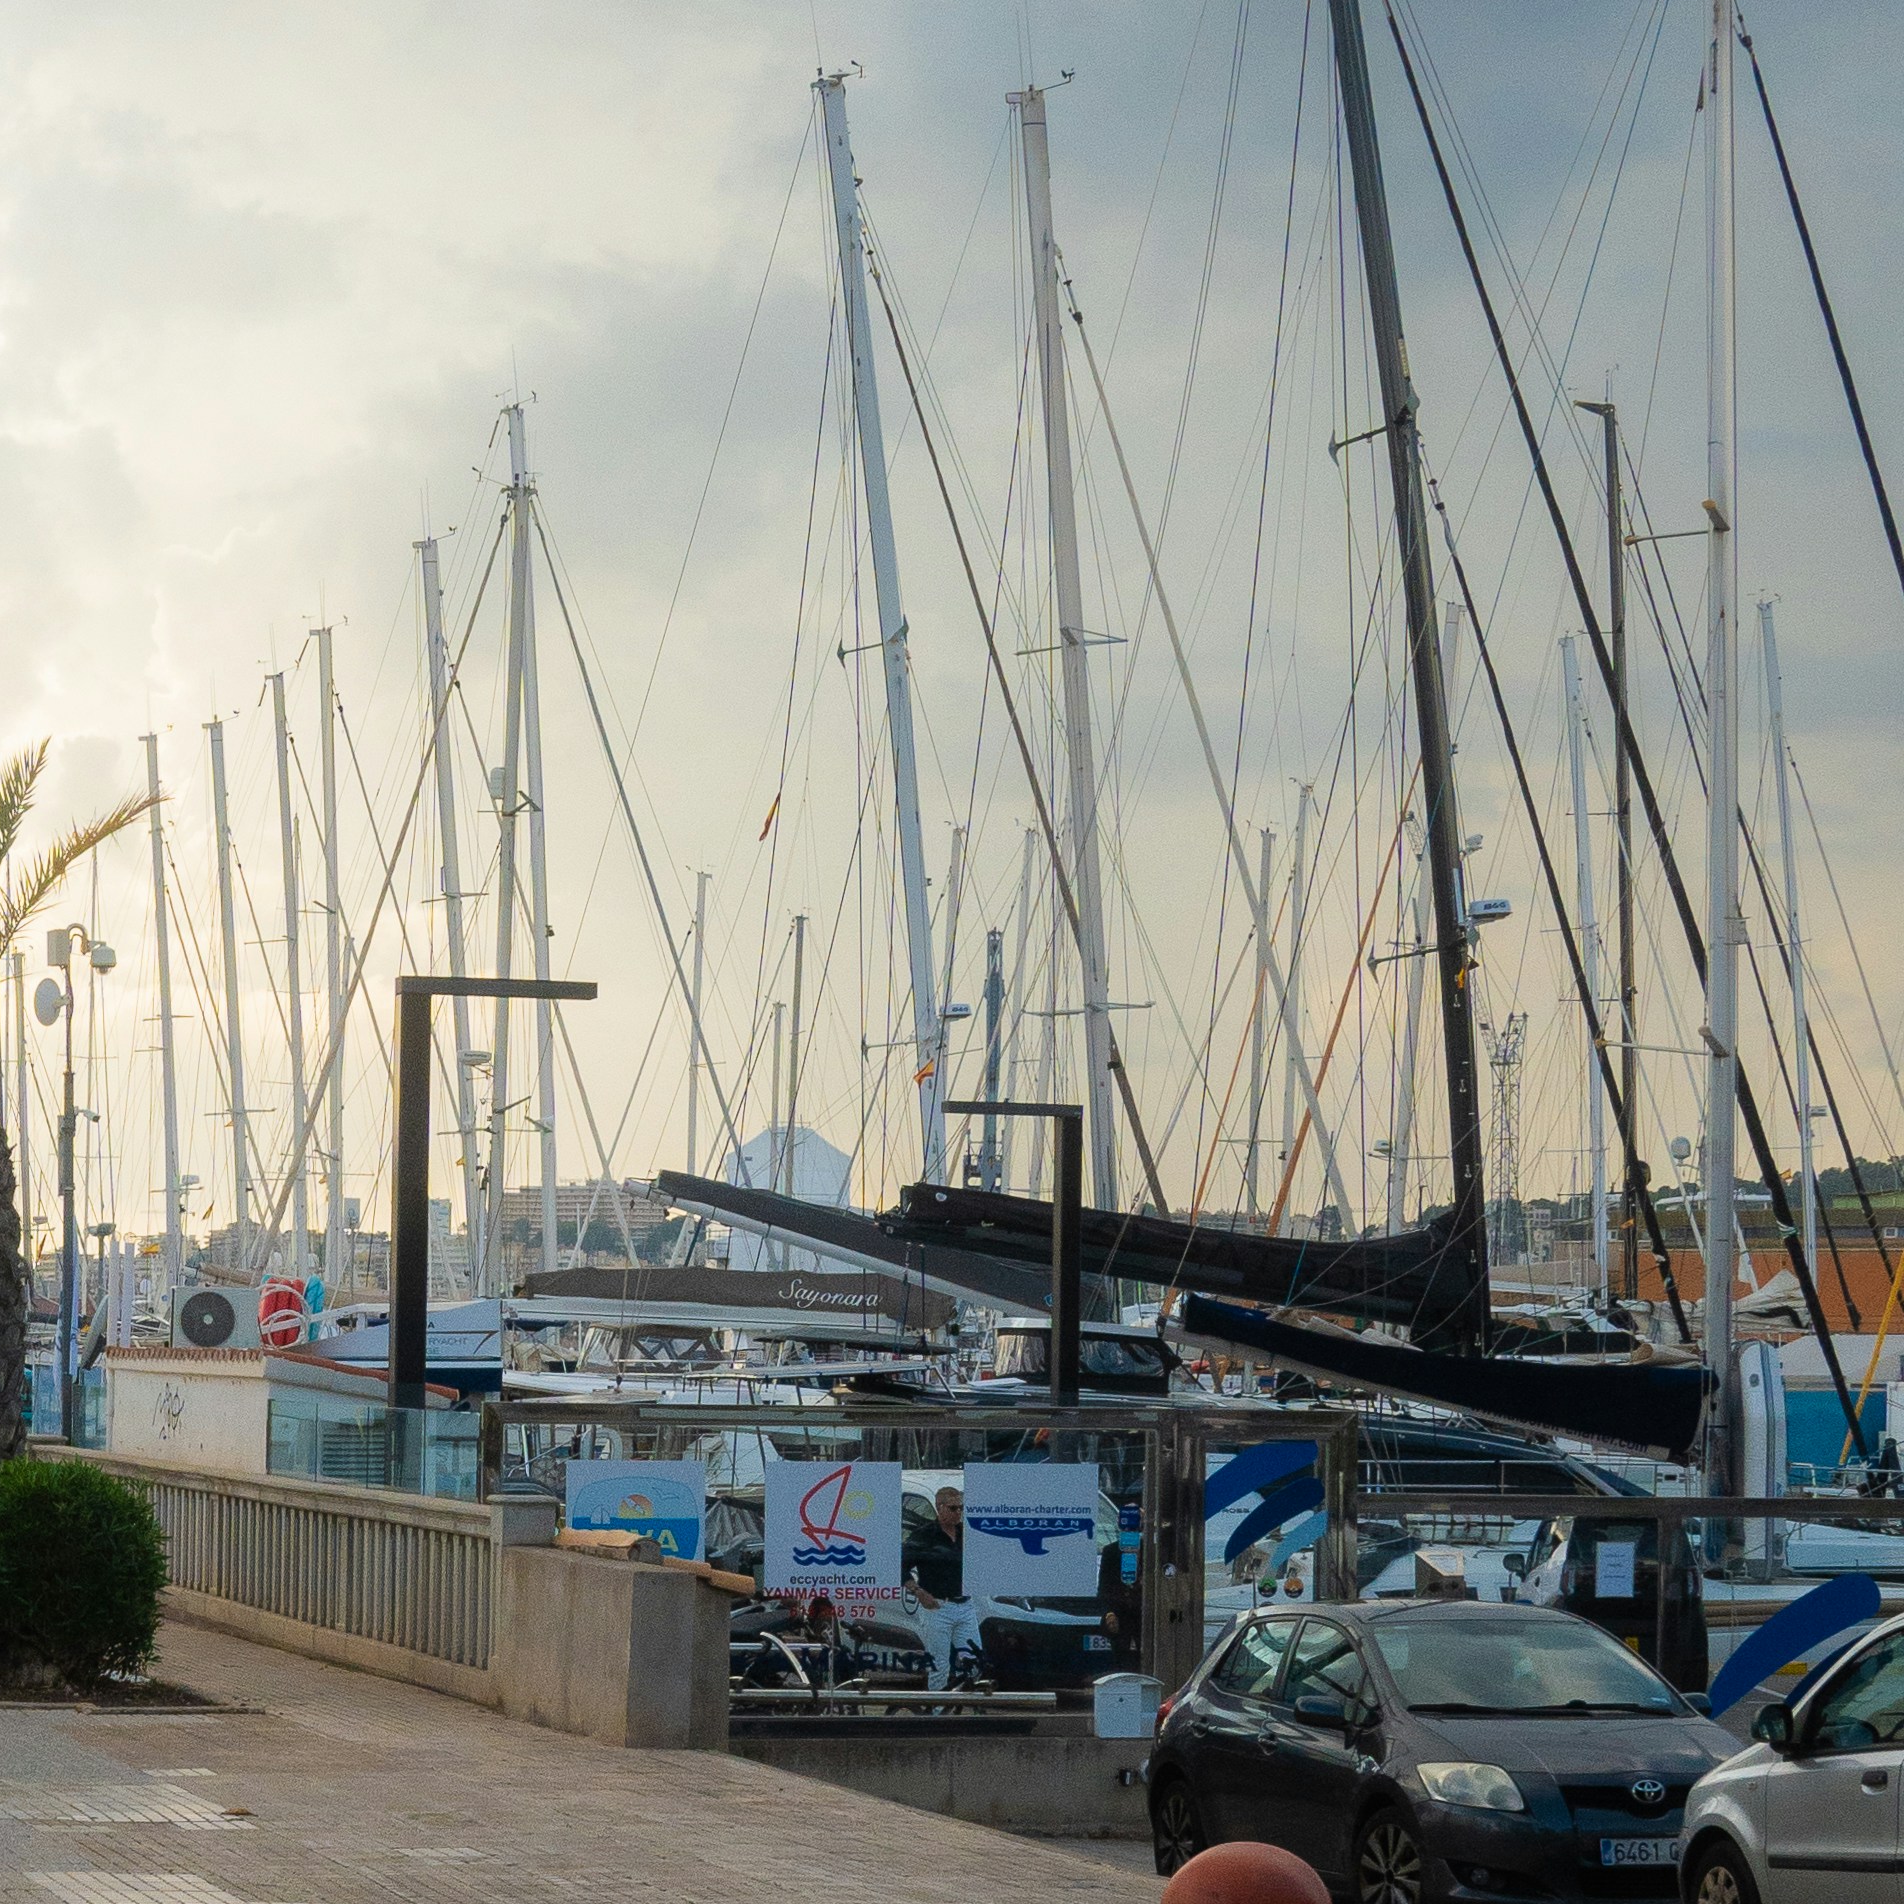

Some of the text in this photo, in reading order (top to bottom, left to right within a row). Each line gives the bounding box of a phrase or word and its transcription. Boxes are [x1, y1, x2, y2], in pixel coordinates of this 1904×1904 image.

[778, 1278, 884, 1308] Sayonara
[966, 1504, 1091, 1514] www.alboran-charter.com
[980, 1519, 1080, 1527] ALBORAN
[789, 1574, 876, 1587] eccyacht.com
[764, 1587, 901, 1600] YANMAR SERVICE
[850, 1605, 876, 1618] 576
[1614, 1841, 1659, 1861] 6461
